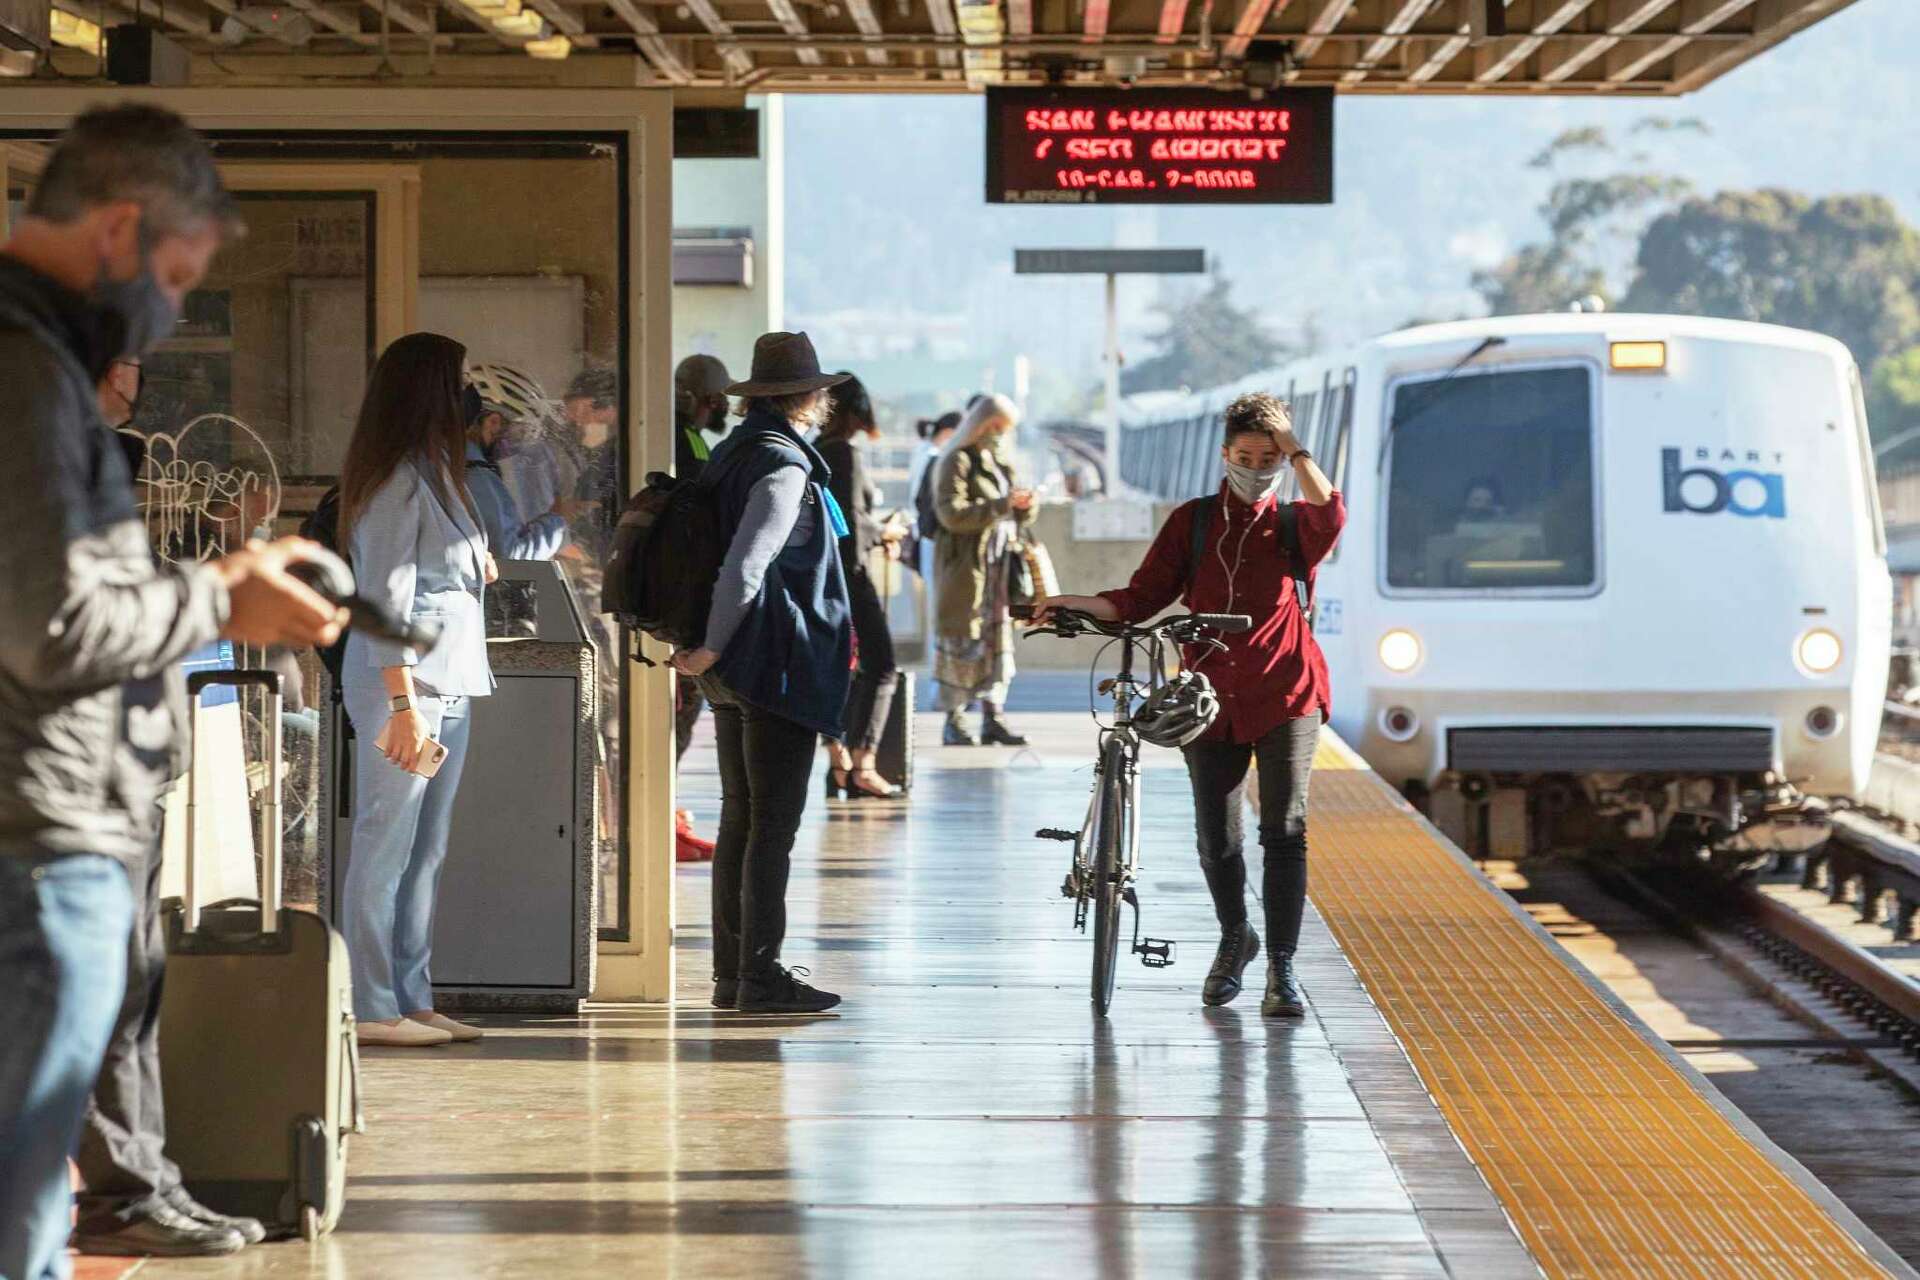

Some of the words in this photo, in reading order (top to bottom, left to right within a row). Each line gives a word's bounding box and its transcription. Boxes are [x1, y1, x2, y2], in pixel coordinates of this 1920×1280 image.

[1025, 108, 1096, 132] SAN
[1004, 189, 1081, 203] PLATFORM
[1695, 447, 1783, 464] BART
